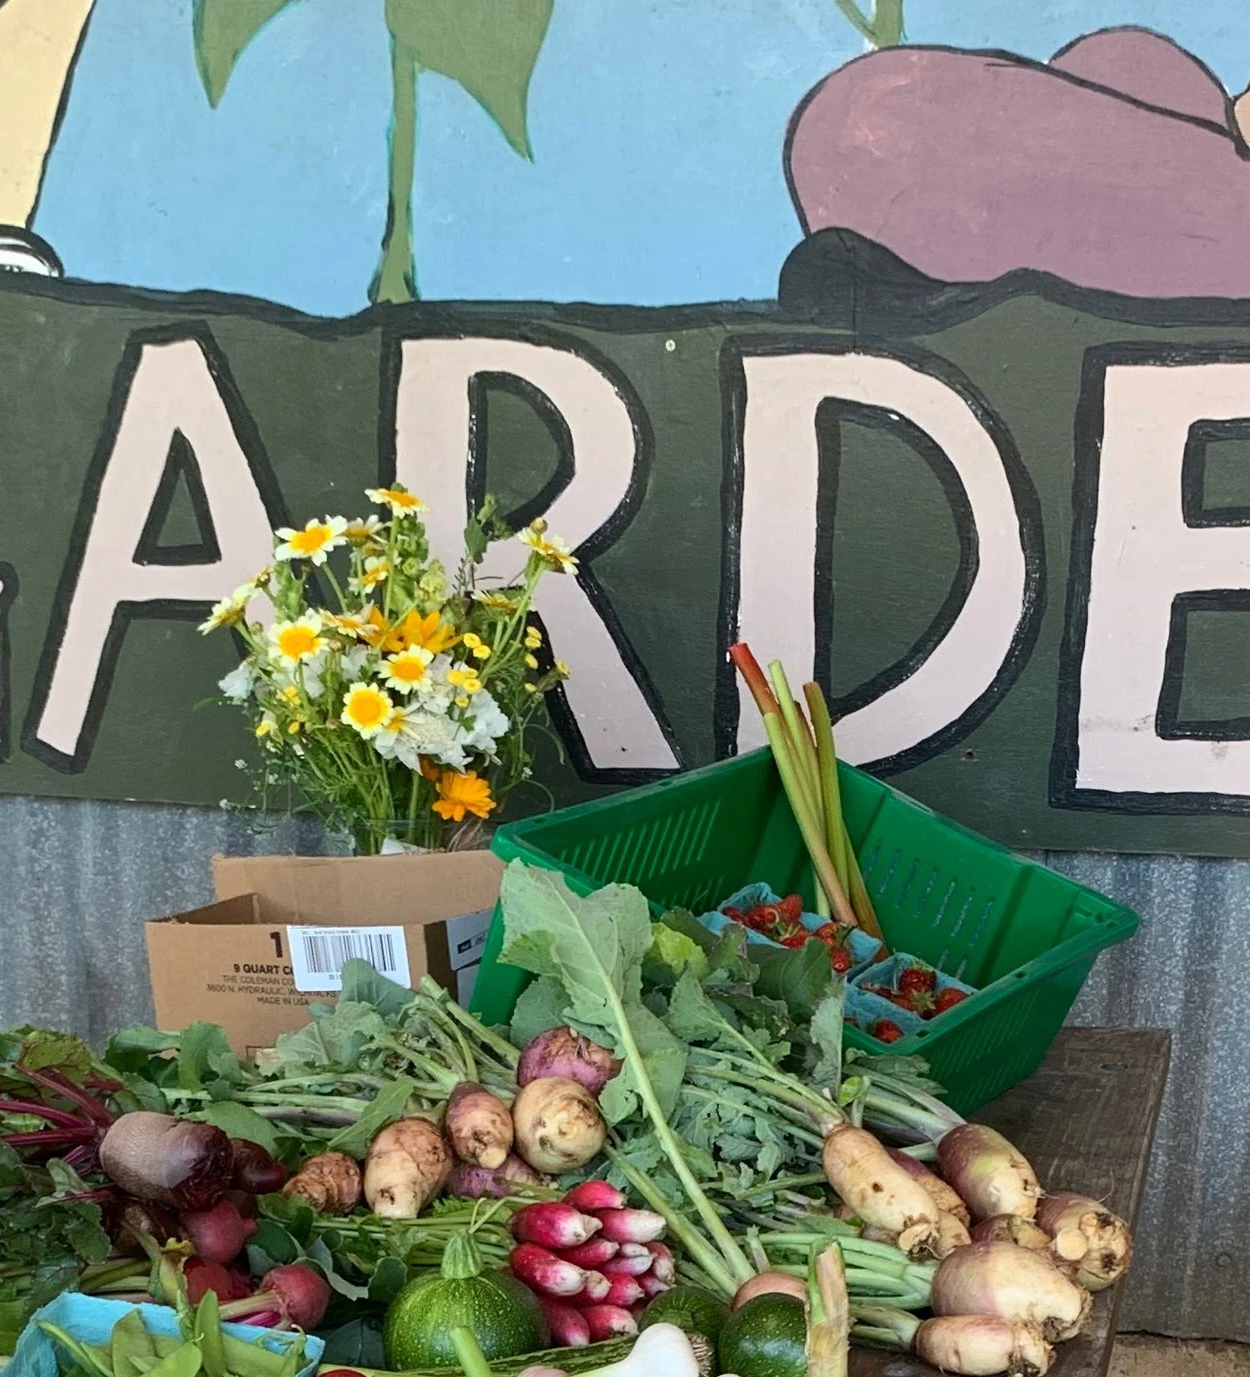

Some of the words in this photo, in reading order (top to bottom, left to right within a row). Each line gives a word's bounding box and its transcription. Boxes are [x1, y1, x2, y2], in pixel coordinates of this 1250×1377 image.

[270, 931, 284, 958] 1
[233, 963, 241, 973] 9
[243, 963, 280, 975] QUART
[222, 974, 237, 983] THE
[240, 975, 280, 986] COLEMAN
[206, 983, 226, 993] 3600
[257, 996, 281, 1005] MADE
[283, 997, 291, 1005] IN
[293, 997, 310, 1006] USA
